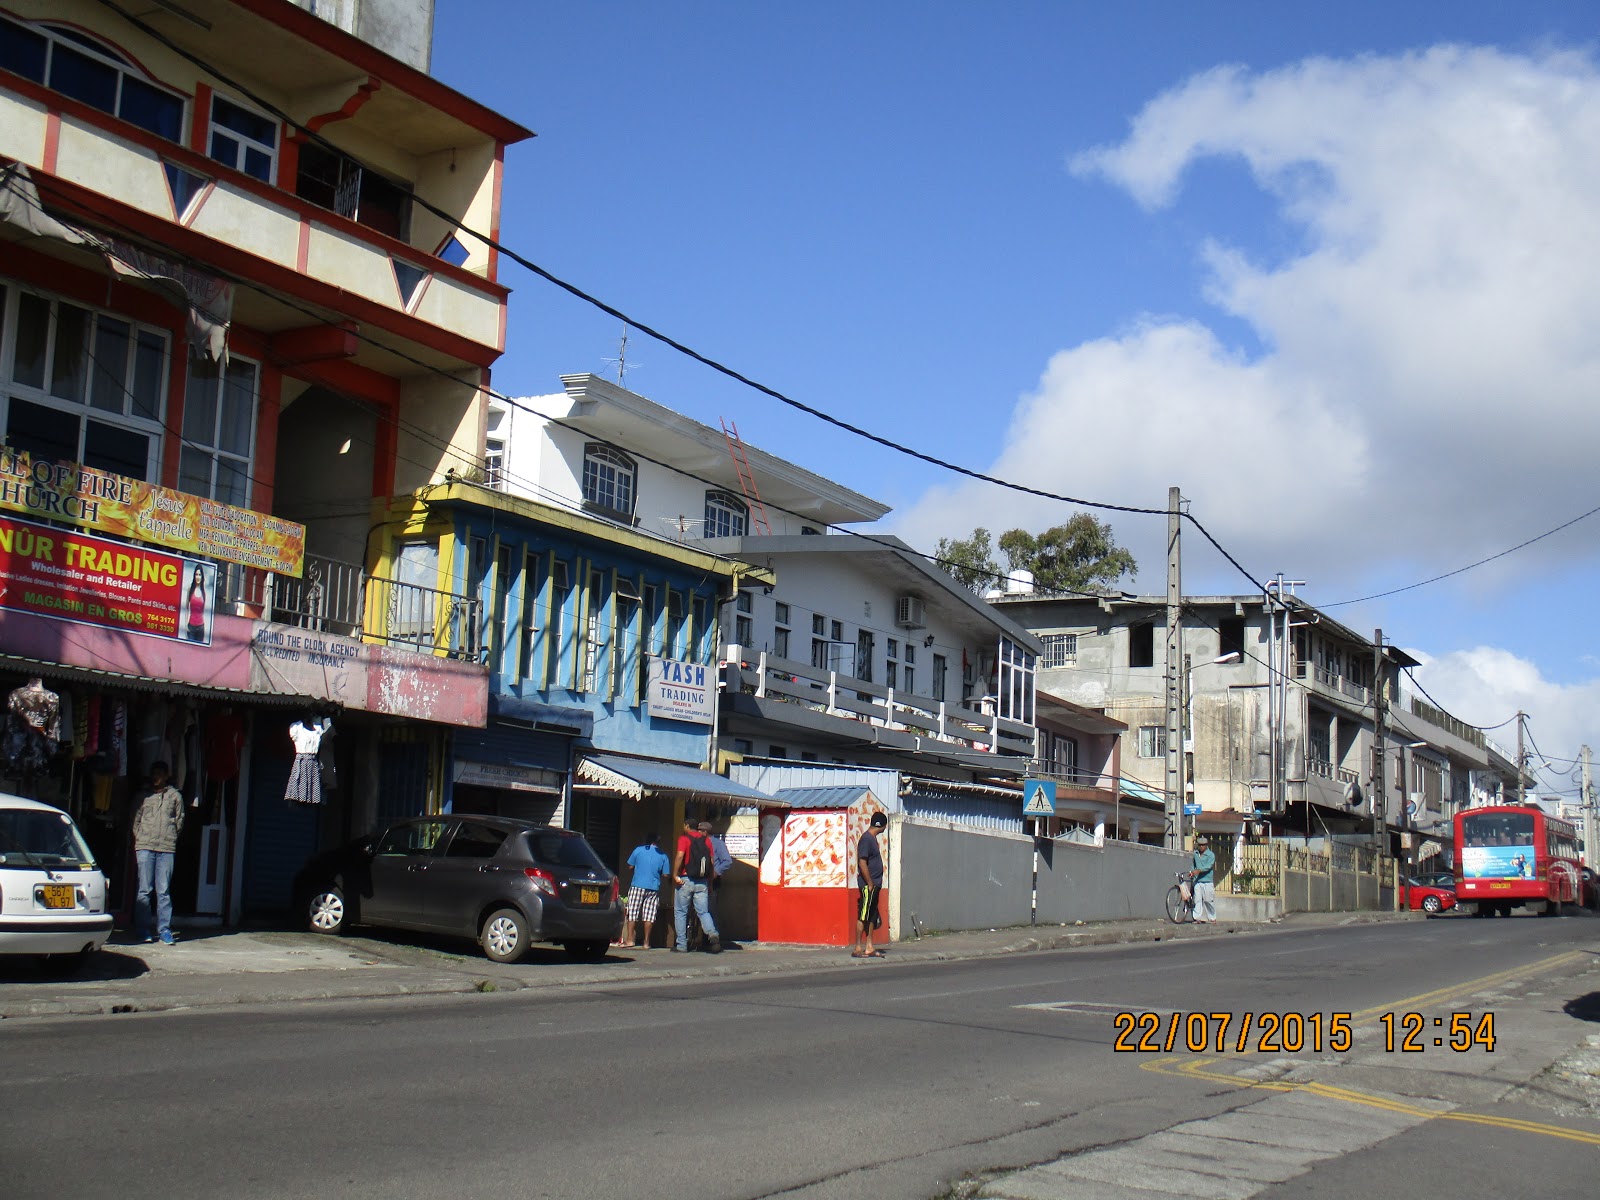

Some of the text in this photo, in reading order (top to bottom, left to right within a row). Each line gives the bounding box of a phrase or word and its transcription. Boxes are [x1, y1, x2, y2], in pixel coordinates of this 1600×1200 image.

[32, 460, 70, 488] OF
[76, 470, 132, 505] FIRE
[1, 479, 100, 524] HURCH
[147, 488, 184, 515] Jésus
[139, 508, 192, 540] t'appelle
[0, 527, 178, 587] NÛR TRADING
[32, 562, 142, 592] Wholesaler and Retailer
[24, 592, 142, 624] MAGASIN EN GROS
[128, 596, 141, 605] Pants
[147, 613, 159, 621] 764
[258, 628, 360, 657] ROUND THE CLOCK AGENCY
[261, 645, 346, 669] ACCREDITED INSURANCE
[662, 661, 704, 686] YASH
[661, 688, 704, 704] TRADING
[52, 886, 66, 897] 567
[61, 897, 70, 907] 97
